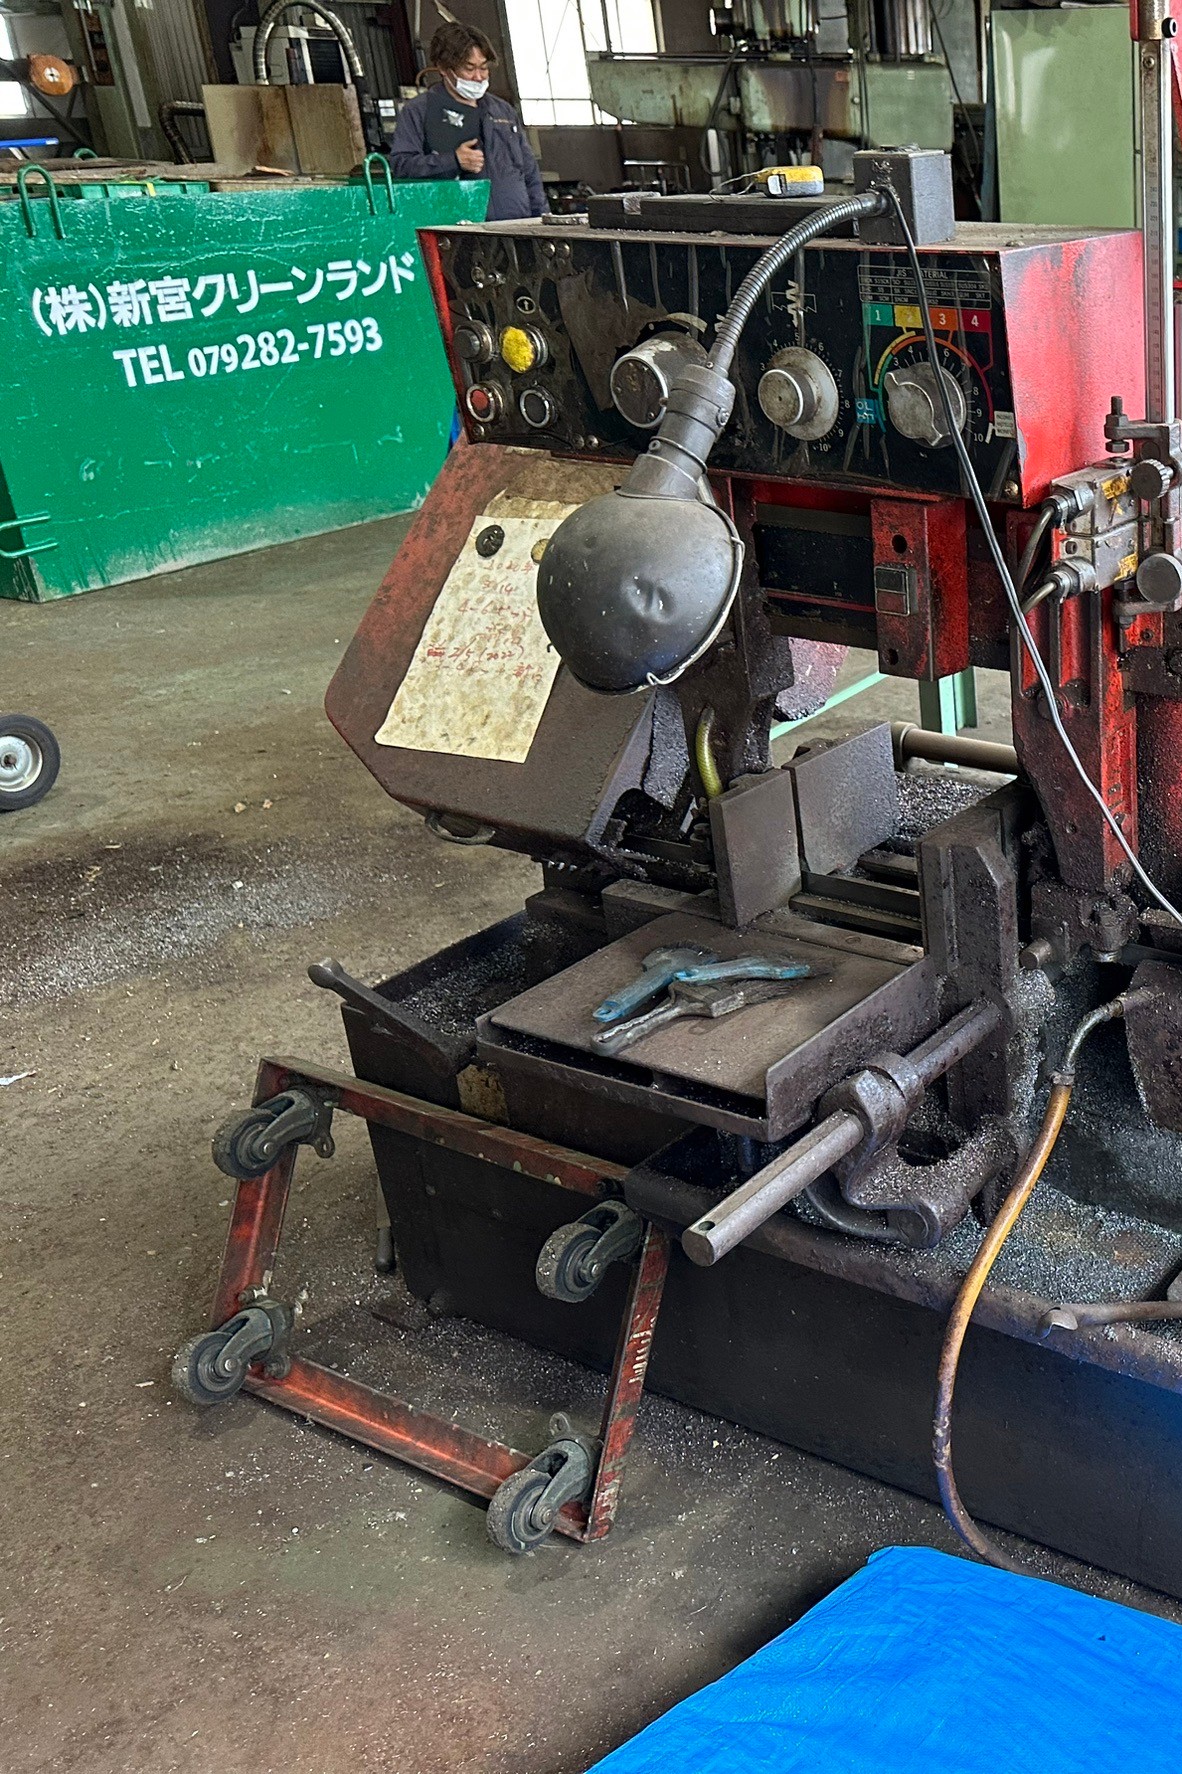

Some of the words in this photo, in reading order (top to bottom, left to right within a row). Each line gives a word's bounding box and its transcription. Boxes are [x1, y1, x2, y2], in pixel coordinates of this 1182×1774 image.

[919, 270, 949, 280] ATERIAL
[32, 252, 416, 337] (株)新宮クリーンランド
[875, 309, 882, 321] 1
[938, 313, 947, 326] 3
[971, 315, 980, 327] 4
[907, 346, 914, 354] 4
[943, 349, 950, 358] 6
[113, 345, 186, 388] TEL
[893, 357, 900, 367] 3
[972, 387, 980, 396] 8
[976, 409, 983, 418] 9
[973, 433, 984, 443] 10
